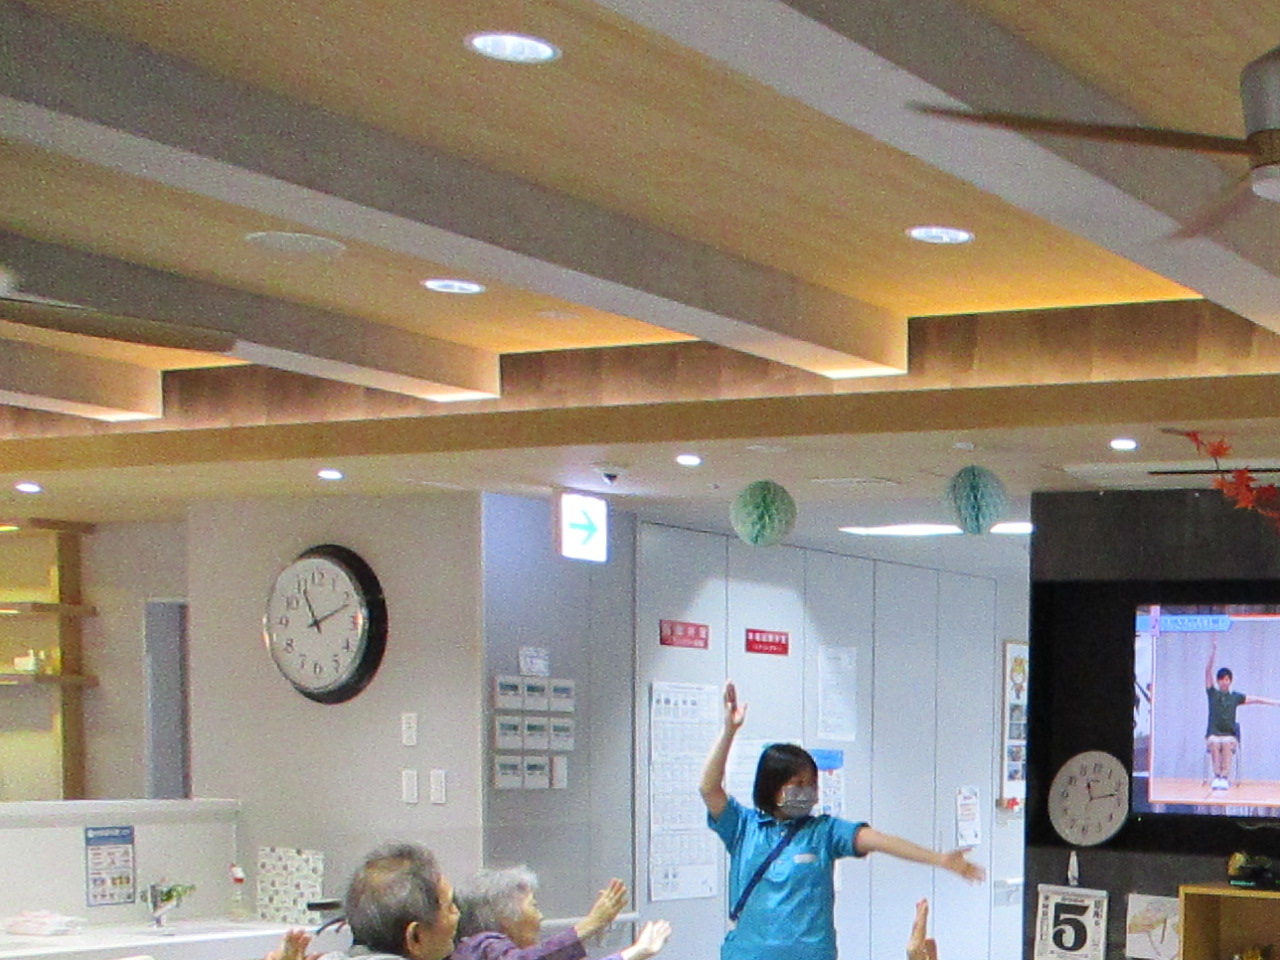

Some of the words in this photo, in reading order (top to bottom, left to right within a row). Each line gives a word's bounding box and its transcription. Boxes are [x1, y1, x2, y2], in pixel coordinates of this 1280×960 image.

[311, 569, 325, 586] 12
[286, 595, 300, 611] 10
[279, 615, 290, 629] 9
[342, 638, 353, 653] 4
[313, 661, 324, 676] 6
[1053, 902, 1089, 951] 5
